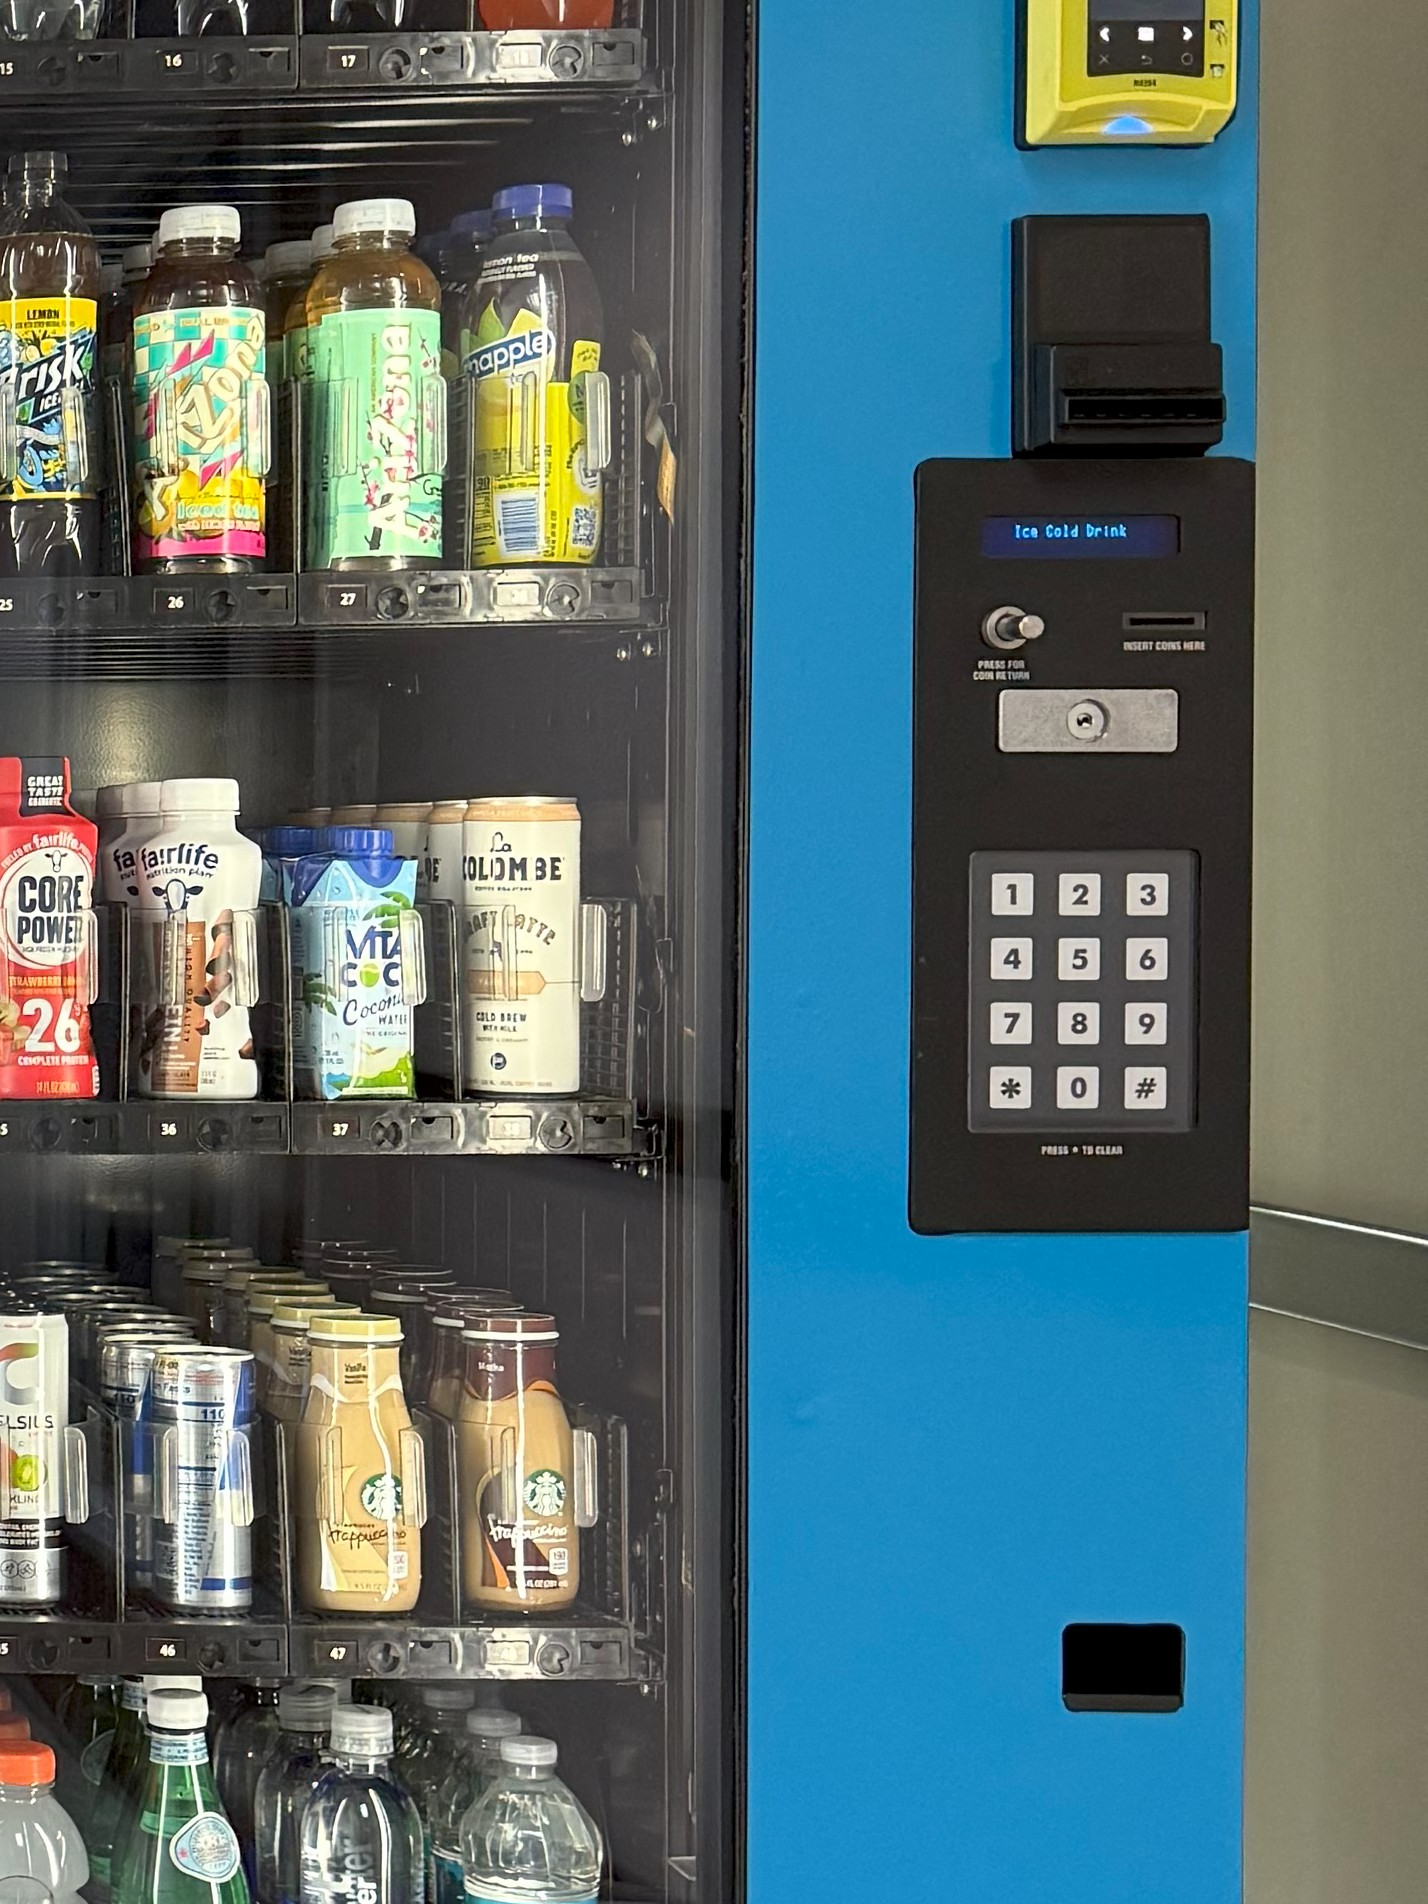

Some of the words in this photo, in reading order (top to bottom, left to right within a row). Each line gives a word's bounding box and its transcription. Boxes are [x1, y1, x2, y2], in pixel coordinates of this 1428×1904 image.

[165, 53, 182, 68] 16
[341, 53, 356, 68] 17
[0, 62, 14, 76] 15
[1015, 524, 1038, 539] Ice
[1046, 524, 1079, 539] Cold
[1086, 524, 1127, 539] Drink
[167, 596, 184, 610] 26
[340, 592, 356, 606] 27
[1123, 641, 1153, 651] INSERT
[1183, 641, 1206, 651] HERE
[978, 660, 1005, 669] PRESS
[996, 671, 1030, 680] RETURN
[17, 875, 84, 914] CORE
[1005, 884, 1017, 905] 1
[1071, 884, 1089, 905] 2
[1140, 884, 1156, 905] 3
[16, 918, 84, 948] POWER
[1003, 948, 1021, 969] 4
[1072, 949, 1088, 970] 5
[1139, 949, 1156, 970] 6
[24, 998, 82, 1053] 26
[1003, 1013, 1020, 1034] 7
[1071, 1013, 1087, 1034] 8
[1138, 1013, 1155, 1034] 9
[1070, 1077, 1087, 1099] 0
[1135, 1077, 1157, 1099] #
[160, 1123, 178, 1137] 36
[332, 1123, 349, 1138] 37
[159, 1643, 176, 1657] 46
